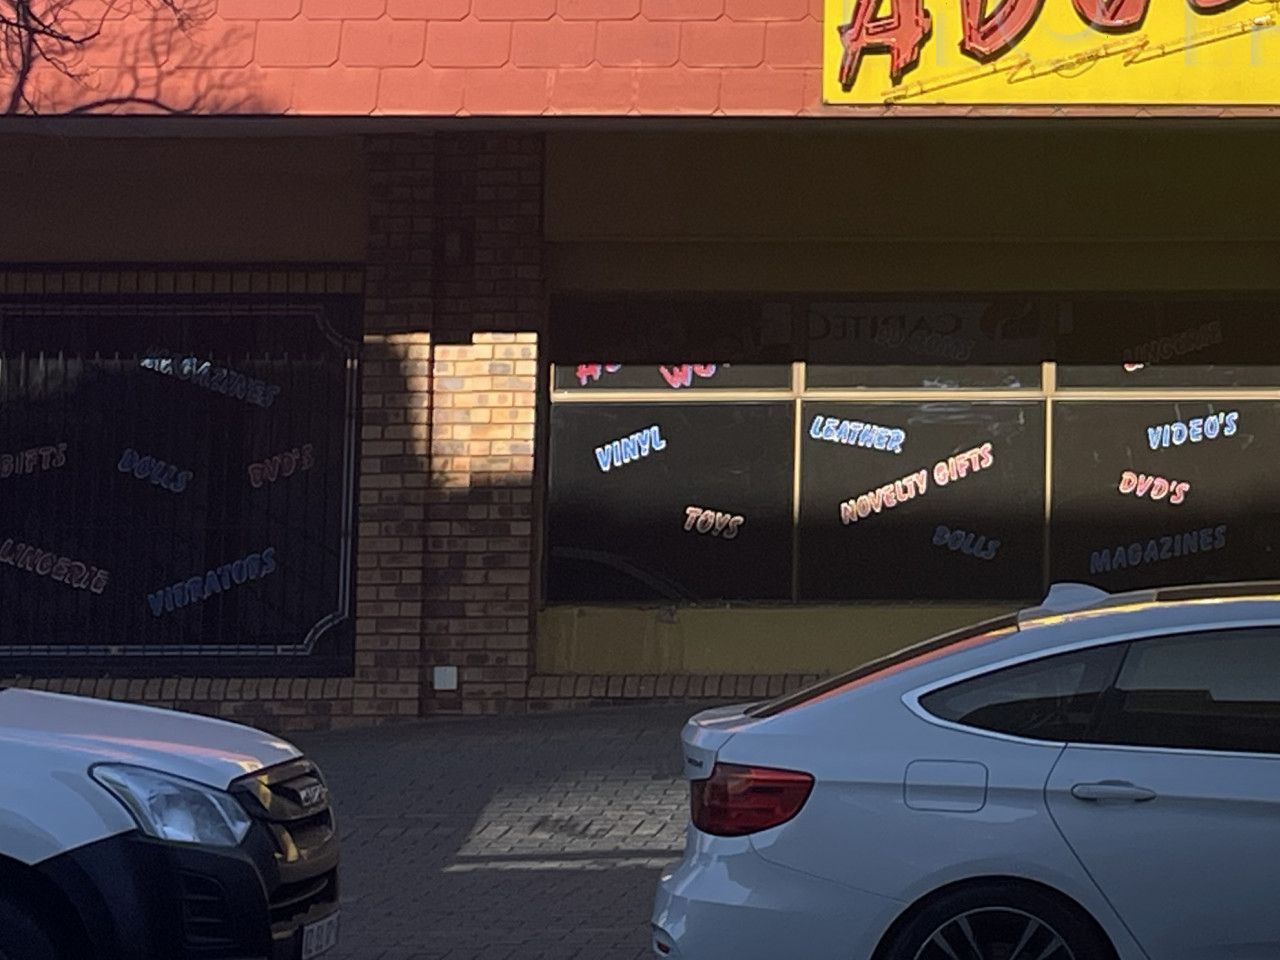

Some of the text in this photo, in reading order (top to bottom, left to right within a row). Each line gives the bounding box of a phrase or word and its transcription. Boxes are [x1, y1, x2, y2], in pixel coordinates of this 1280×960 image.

[595, 424, 667, 472] VINYL
[809, 415, 906, 453] LEATHER
[1147, 411, 1239, 450] VIDEO'S
[117, 448, 194, 494] DOLLS
[839, 442, 994, 525] NOVELTY GIFTS
[1118, 470, 1191, 505] DVD'S
[683, 505, 745, 539] TOYS
[930, 524, 1001, 561] DOLLS
[0, 538, 111, 595] LINGERIE
[1088, 523, 1228, 576] MAGAZINES
[147, 548, 277, 618] VIBRATORS
